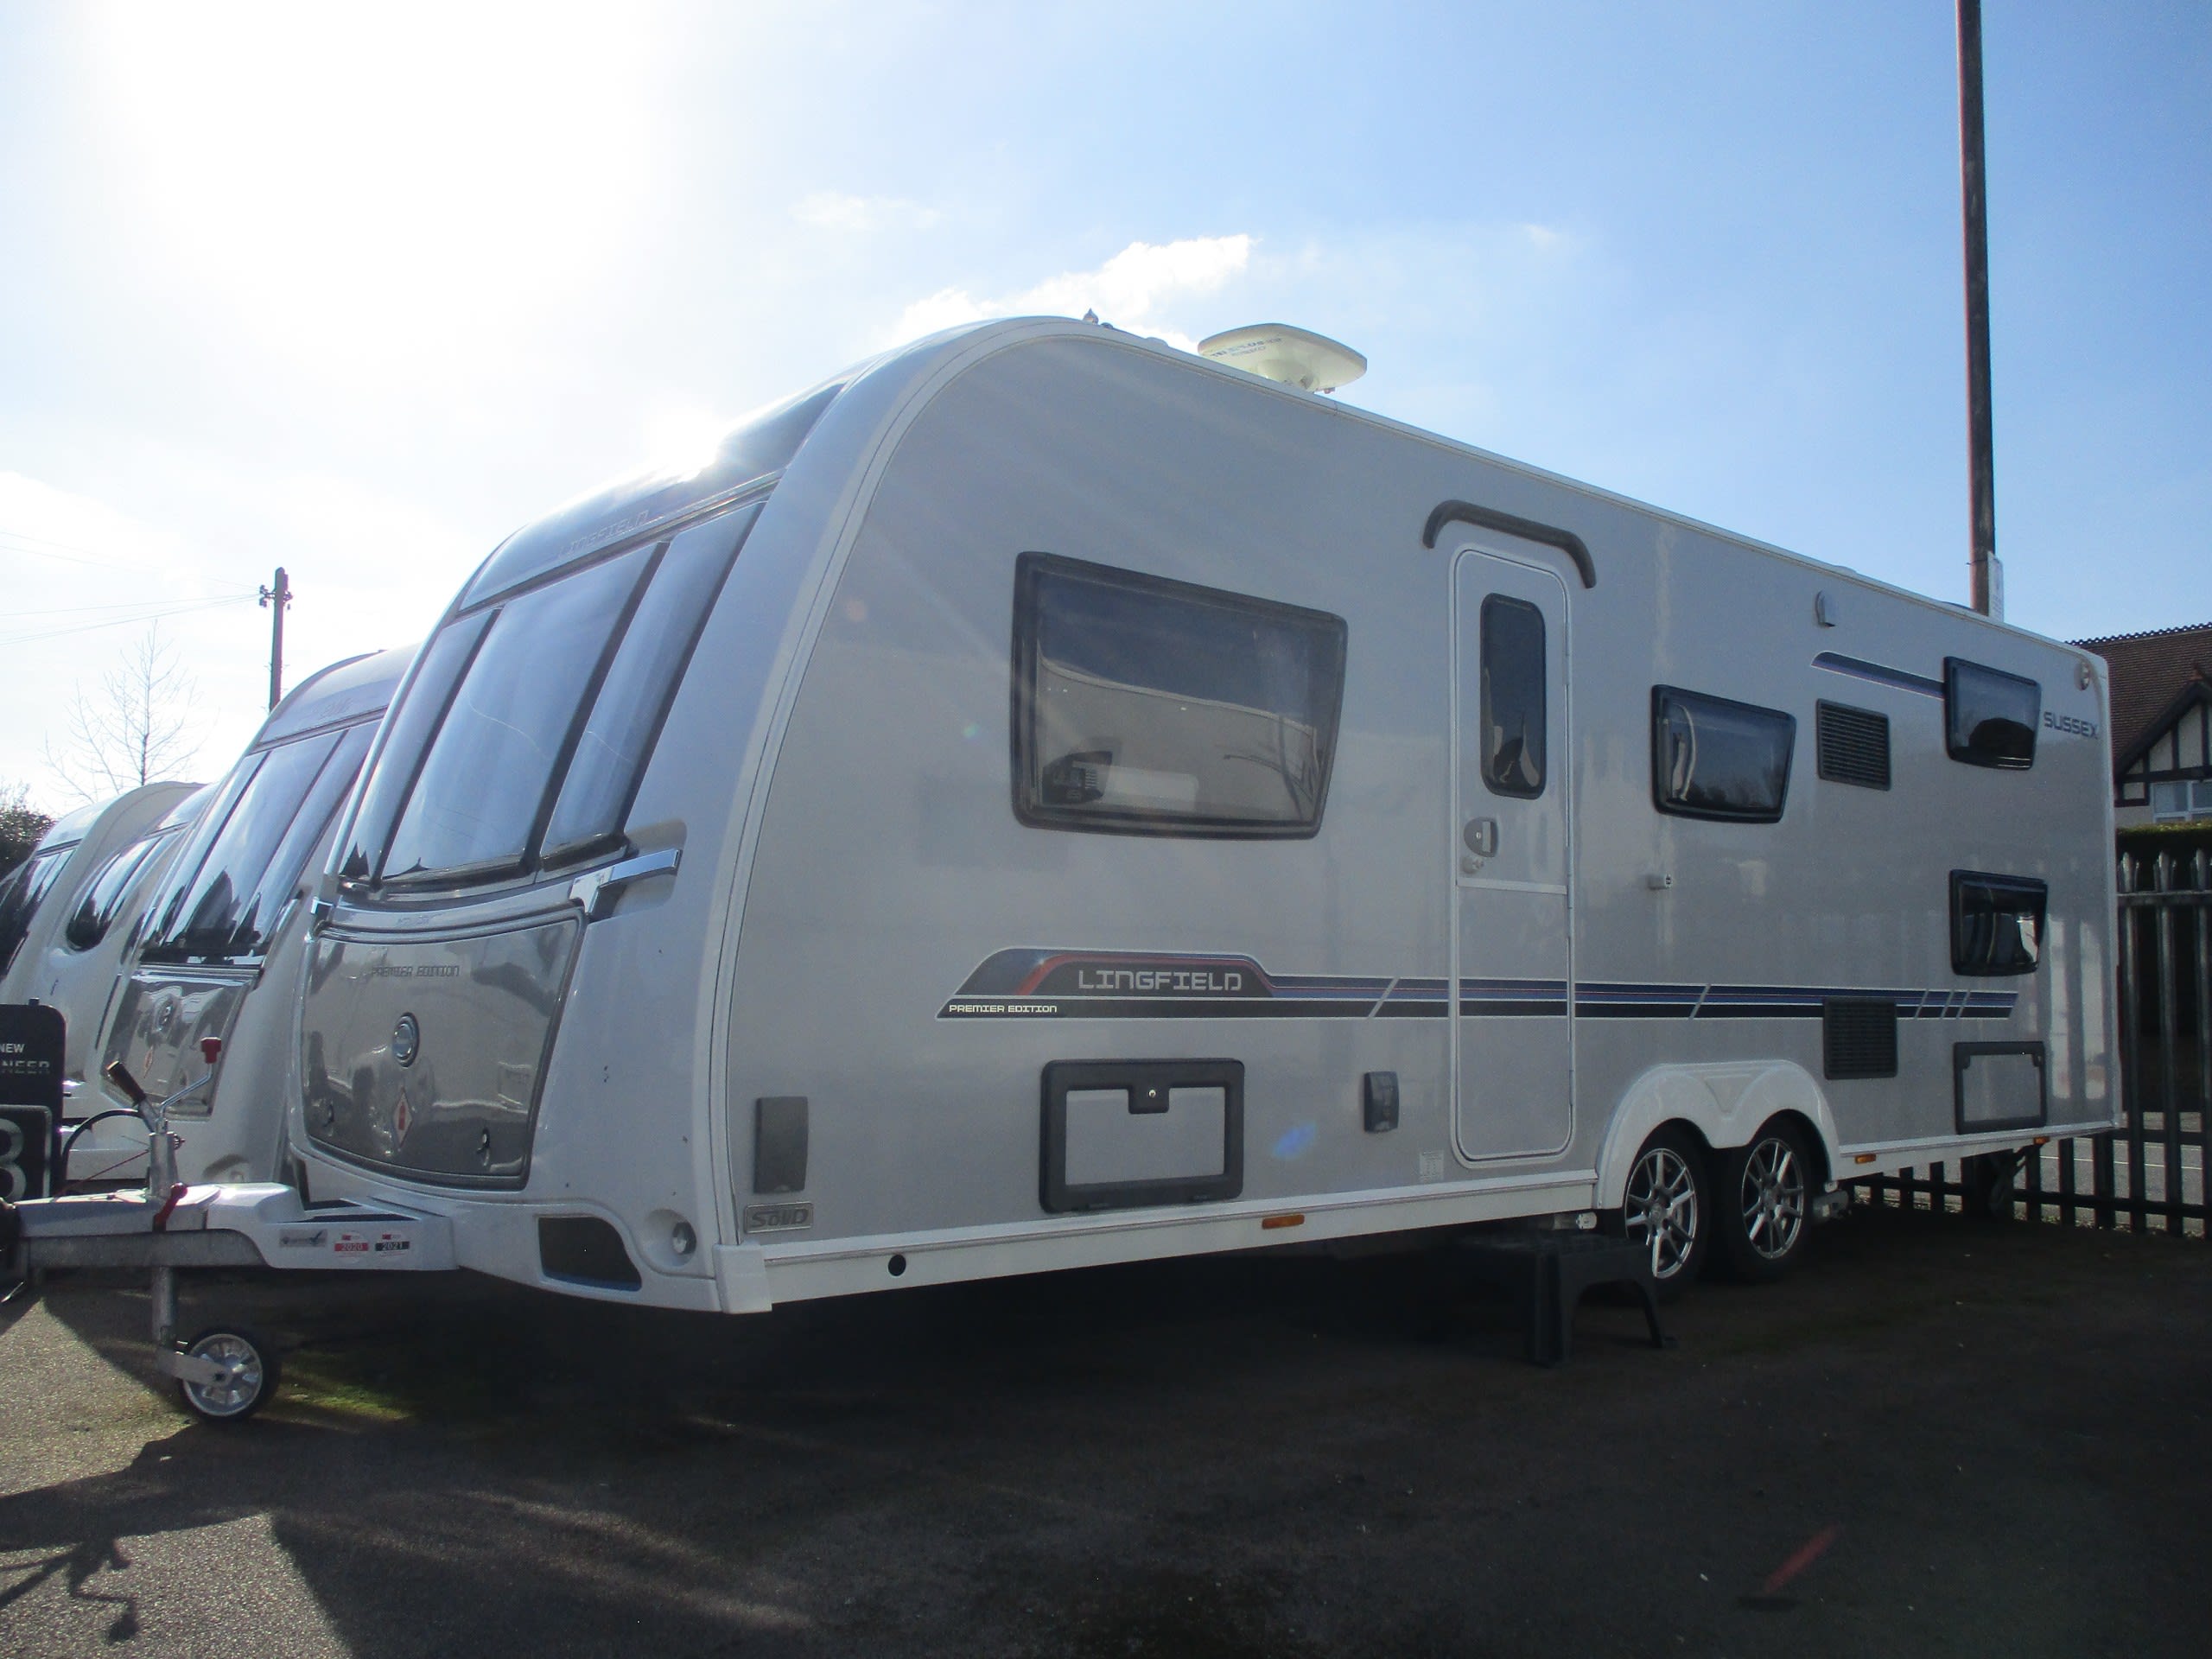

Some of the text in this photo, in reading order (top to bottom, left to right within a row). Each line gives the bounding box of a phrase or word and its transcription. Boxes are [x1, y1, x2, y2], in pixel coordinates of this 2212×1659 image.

[2043, 711, 2098, 740] SUSSEX
[372, 964, 460, 977] PREMIER EDITION
[1077, 969, 1243, 991] LINGFIELD
[949, 1004, 1058, 1014] PREMIER EDITION
